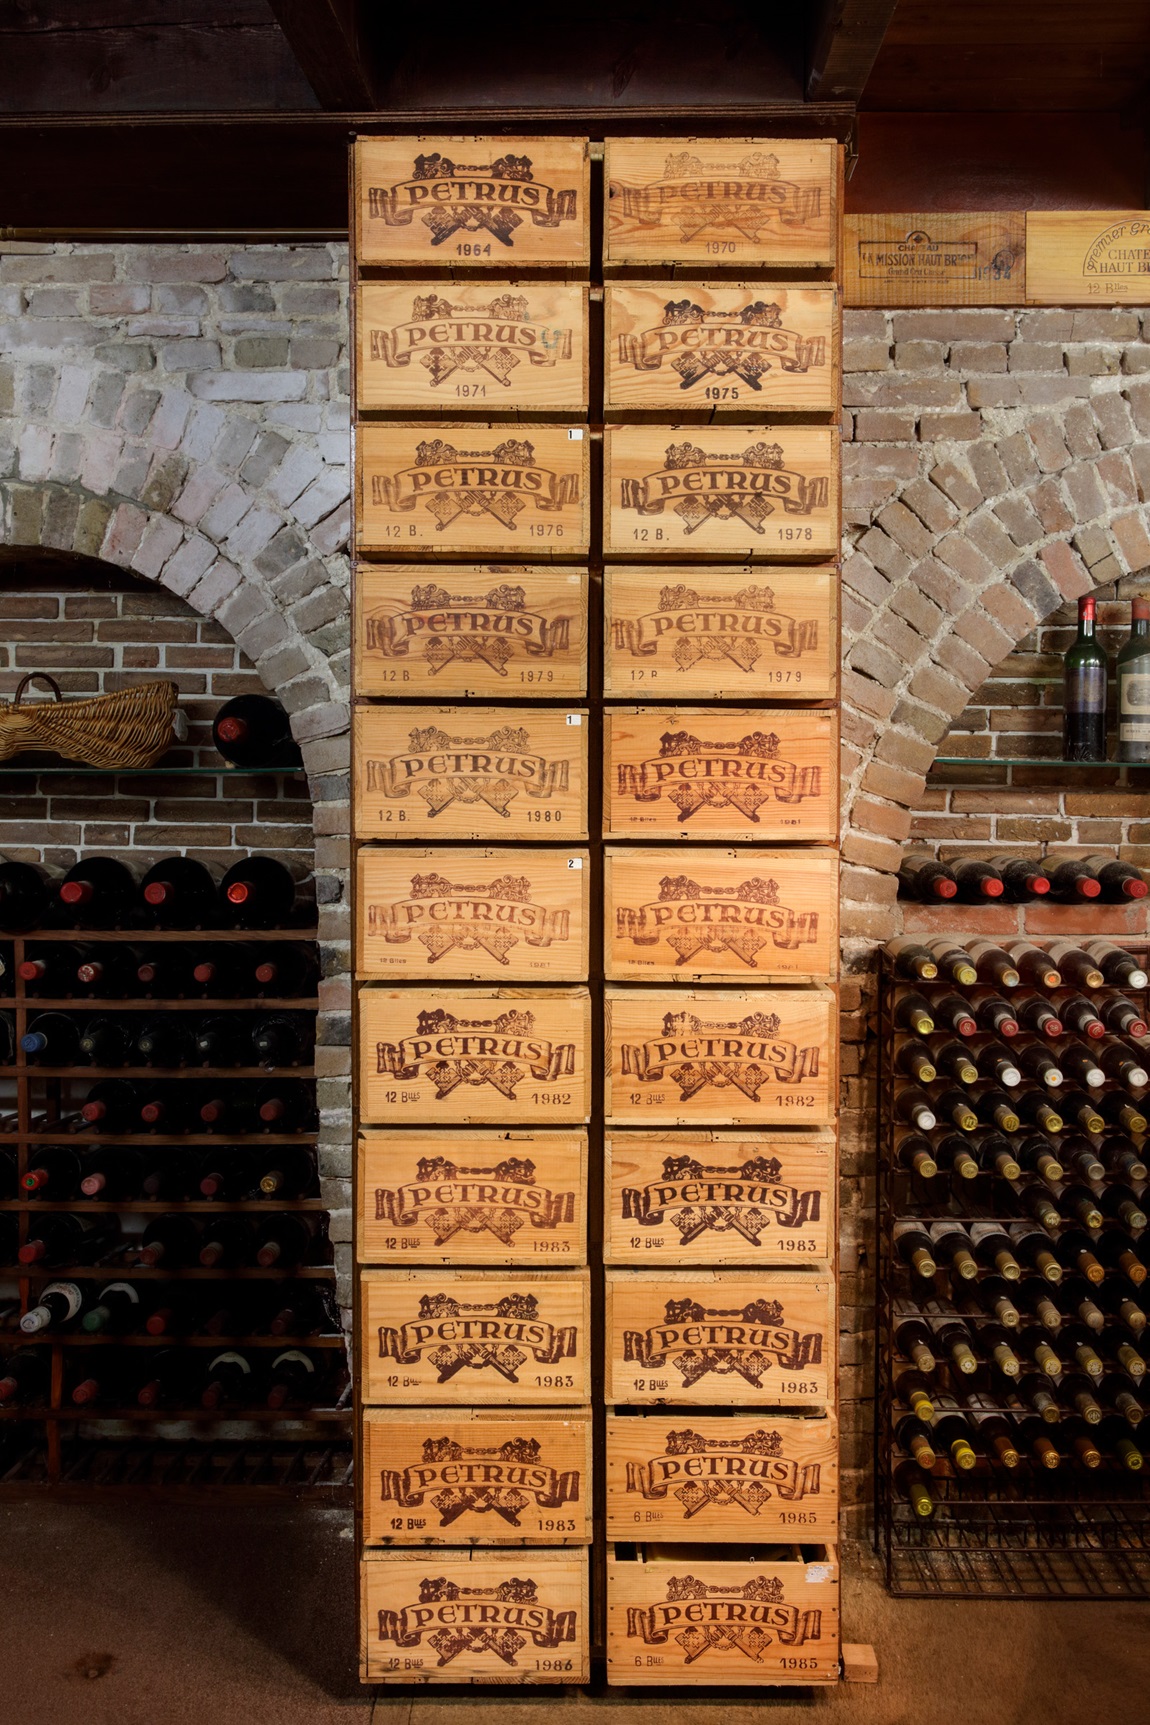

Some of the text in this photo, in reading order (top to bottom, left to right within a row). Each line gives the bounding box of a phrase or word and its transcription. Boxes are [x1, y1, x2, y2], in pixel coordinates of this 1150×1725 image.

[408, 181, 540, 205] PETRUS
[659, 181, 786, 204] PETRUS
[456, 244, 491, 256] 1964
[706, 241, 736, 254] 1970
[1087, 226, 1126, 273] Premier
[876, 253, 915, 267] MISSION
[918, 253, 942, 267] HAUT
[1100, 262, 1133, 273] HAUT
[1087, 282, 1100, 294] 12
[407, 323, 537, 346] PETRUS
[655, 326, 789, 350] PETRUS
[456, 385, 486, 397] 1971
[706, 387, 739, 400] 1975
[568, 431, 573, 439] 1
[408, 468, 542, 491] PETRUS
[661, 471, 792, 495] PETRUS
[386, 524, 424, 538] 12 B.
[529, 523, 564, 537] 1976
[633, 528, 670, 541] 12 B.
[778, 528, 813, 541] 1978
[402, 613, 534, 637] PETRUS
[651, 613, 782, 636] PETRUS
[382, 670, 396, 681] 12
[520, 671, 554, 682] 1979
[631, 670, 645, 681] 12
[768, 672, 802, 683] 1979
[567, 716, 572, 724] 1
[400, 754, 538, 778] PETRUS
[651, 758, 786, 782] PETRUS
[378, 810, 410, 822] 12 B.
[527, 810, 562, 822] 1980
[568, 860, 574, 868] 2
[402, 900, 538, 926] PETRUS
[650, 903, 785, 928] PETRUS
[409, 1036, 542, 1060] PETRUS
[654, 1039, 787, 1062] PETRUS
[386, 1092, 397, 1102] 12
[532, 1094, 571, 1104] 1982
[630, 1093, 641, 1104] 12
[776, 1096, 814, 1107] 1982
[409, 1184, 542, 1208] PETRUS
[655, 1182, 789, 1206] PETRUS
[386, 1238, 397, 1249] 12
[533, 1241, 570, 1252] 1983
[630, 1237, 641, 1248] 12
[777, 1240, 816, 1251] 1983
[410, 1320, 545, 1344] PETRUS
[657, 1326, 790, 1349] PETRUS
[387, 1375, 398, 1386] 12
[535, 1376, 574, 1387] 1983
[633, 1379, 644, 1390] 12
[781, 1382, 818, 1394] 1983
[658, 1457, 789, 1480] PETRUS
[414, 1464, 548, 1488] PETRUS
[634, 1511, 641, 1522] 6
[779, 1512, 817, 1523] 1985
[390, 1518, 403, 1529] 12
[538, 1519, 575, 1531] 1983
[410, 1605, 544, 1628] PETRUS
[660, 1602, 791, 1625] PETRUS
[389, 1658, 399, 1669] 12
[535, 1660, 573, 1671] 1986
[635, 1656, 641, 1666] 6
[779, 1658, 818, 1669] 1985
